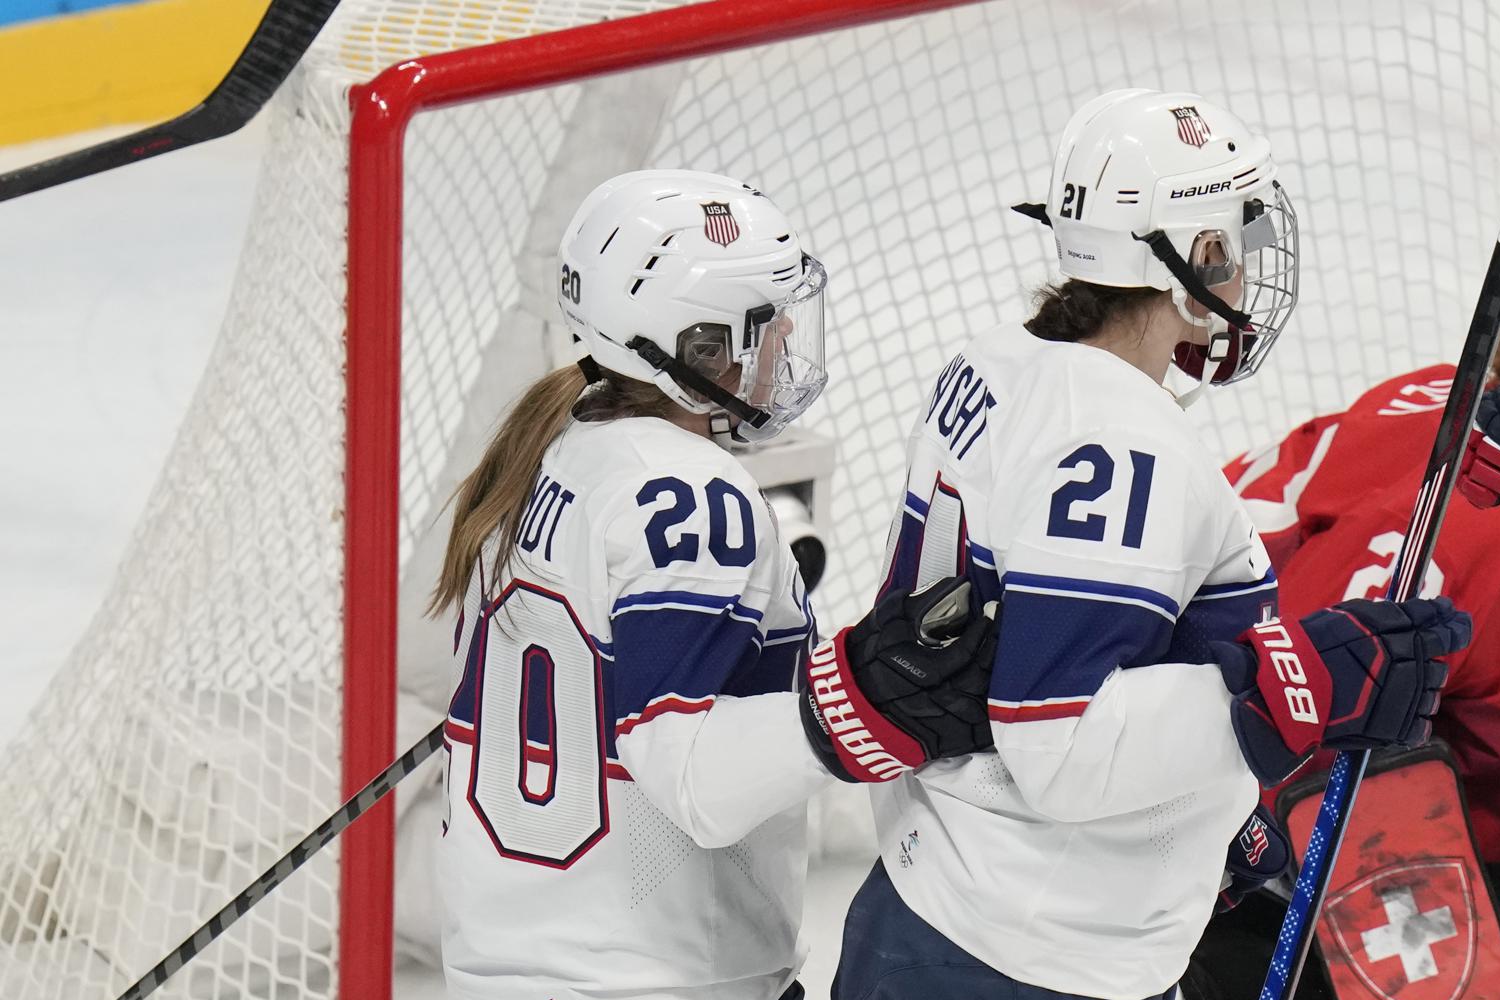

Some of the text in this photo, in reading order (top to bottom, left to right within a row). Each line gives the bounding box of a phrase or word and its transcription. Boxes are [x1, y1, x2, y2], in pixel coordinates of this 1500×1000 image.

[706, 205, 728, 216] USA
[1059, 183, 1088, 221] 21
[1170, 180, 1232, 199] BAUER
[561, 263, 582, 305] 20
[1045, 443, 1157, 550] 21
[635, 475, 757, 569] 20
[809, 638, 915, 780] WARRIO
